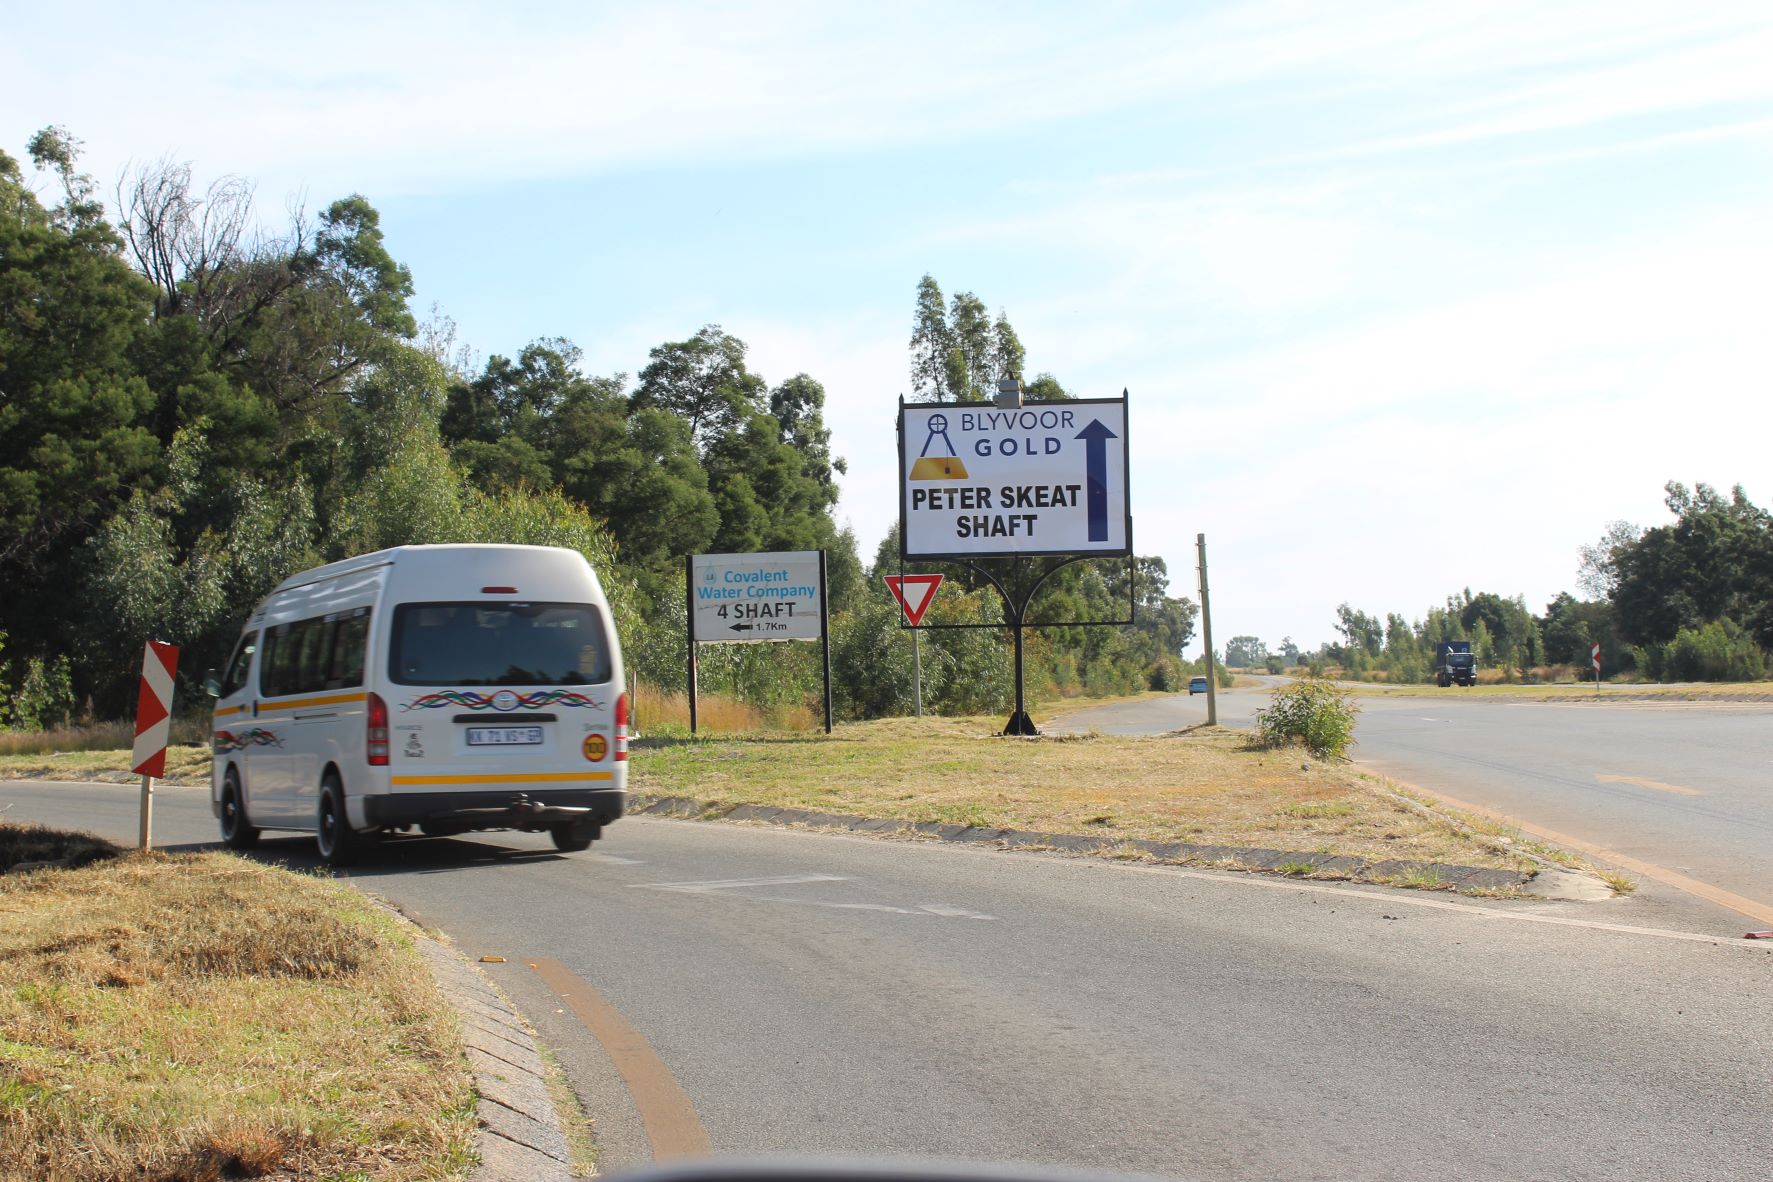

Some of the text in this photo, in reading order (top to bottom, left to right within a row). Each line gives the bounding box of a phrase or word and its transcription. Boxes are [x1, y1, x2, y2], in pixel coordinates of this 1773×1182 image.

[961, 411, 1074, 431] BLYVOOR
[974, 437, 1062, 457] GOLD
[912, 484, 1081, 510] PETER SKEAT
[956, 514, 1038, 538] SHAFT
[724, 569, 788, 583] Covalent
[698, 585, 816, 599] Water Company
[717, 602, 796, 619] 4 SHAFT
[756, 622, 787, 631] 1.7Km
